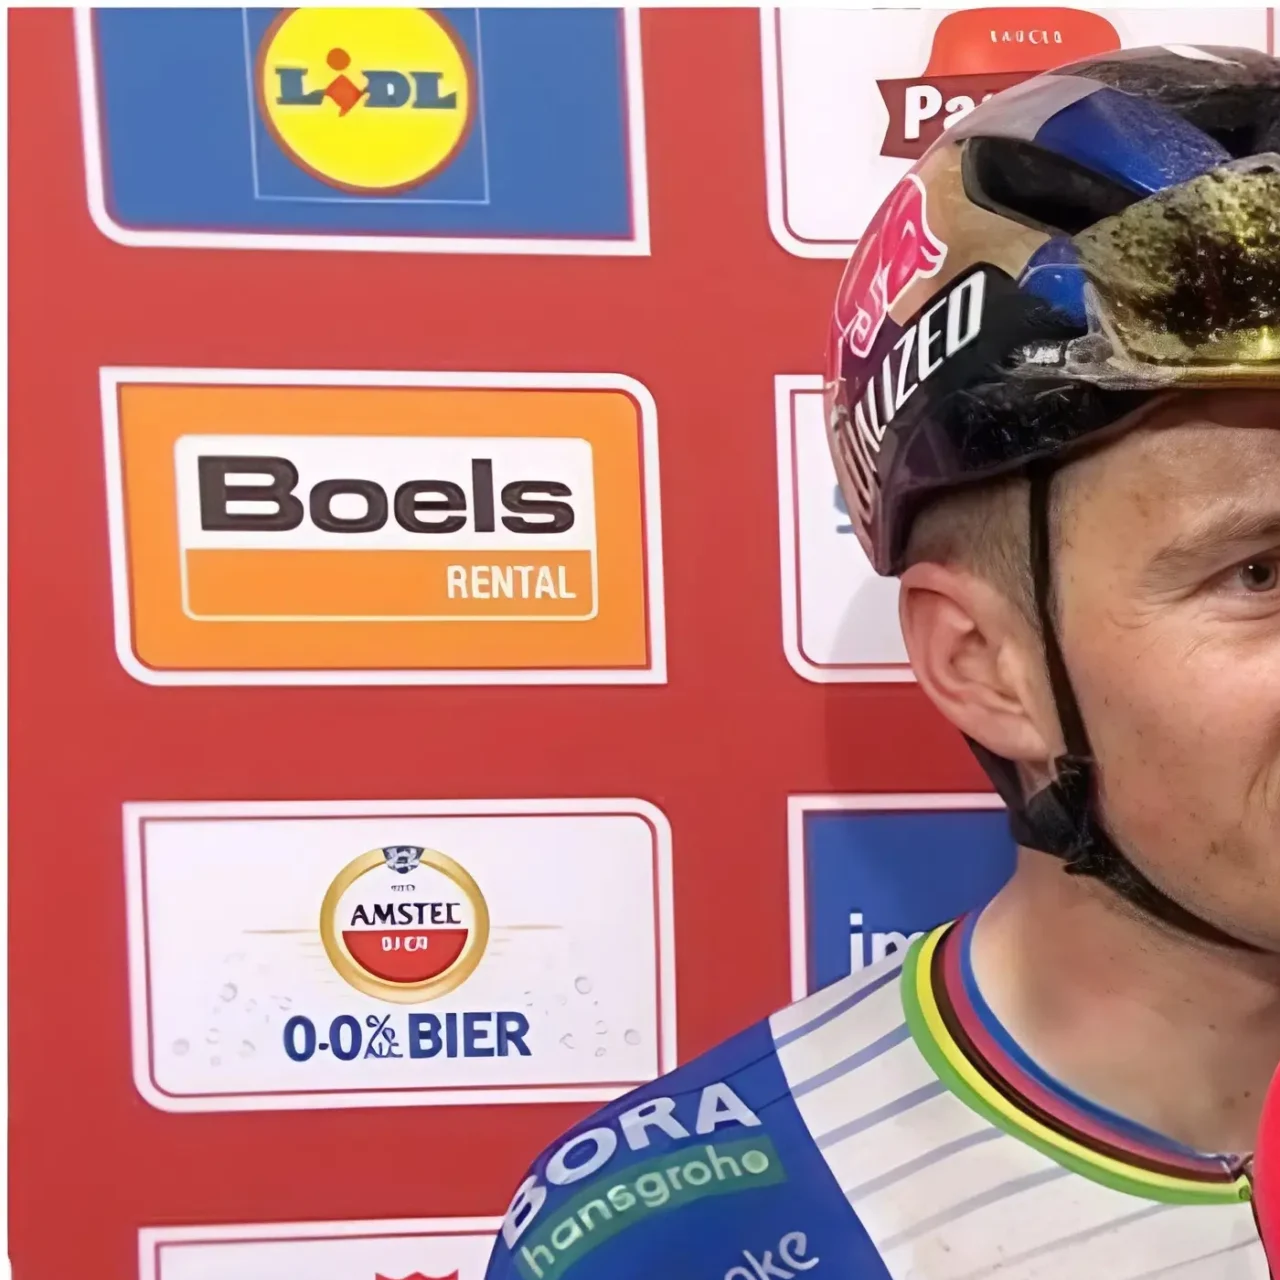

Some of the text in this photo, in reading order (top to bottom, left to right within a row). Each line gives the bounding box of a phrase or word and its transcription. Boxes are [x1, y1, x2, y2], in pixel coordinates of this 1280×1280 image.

[904, 84, 994, 141] Pa
[197, 454, 576, 534] Boels
[446, 564, 577, 600] RENTAL
[408, 1011, 533, 1059] BIER
[502, 1082, 763, 1250] BORA
